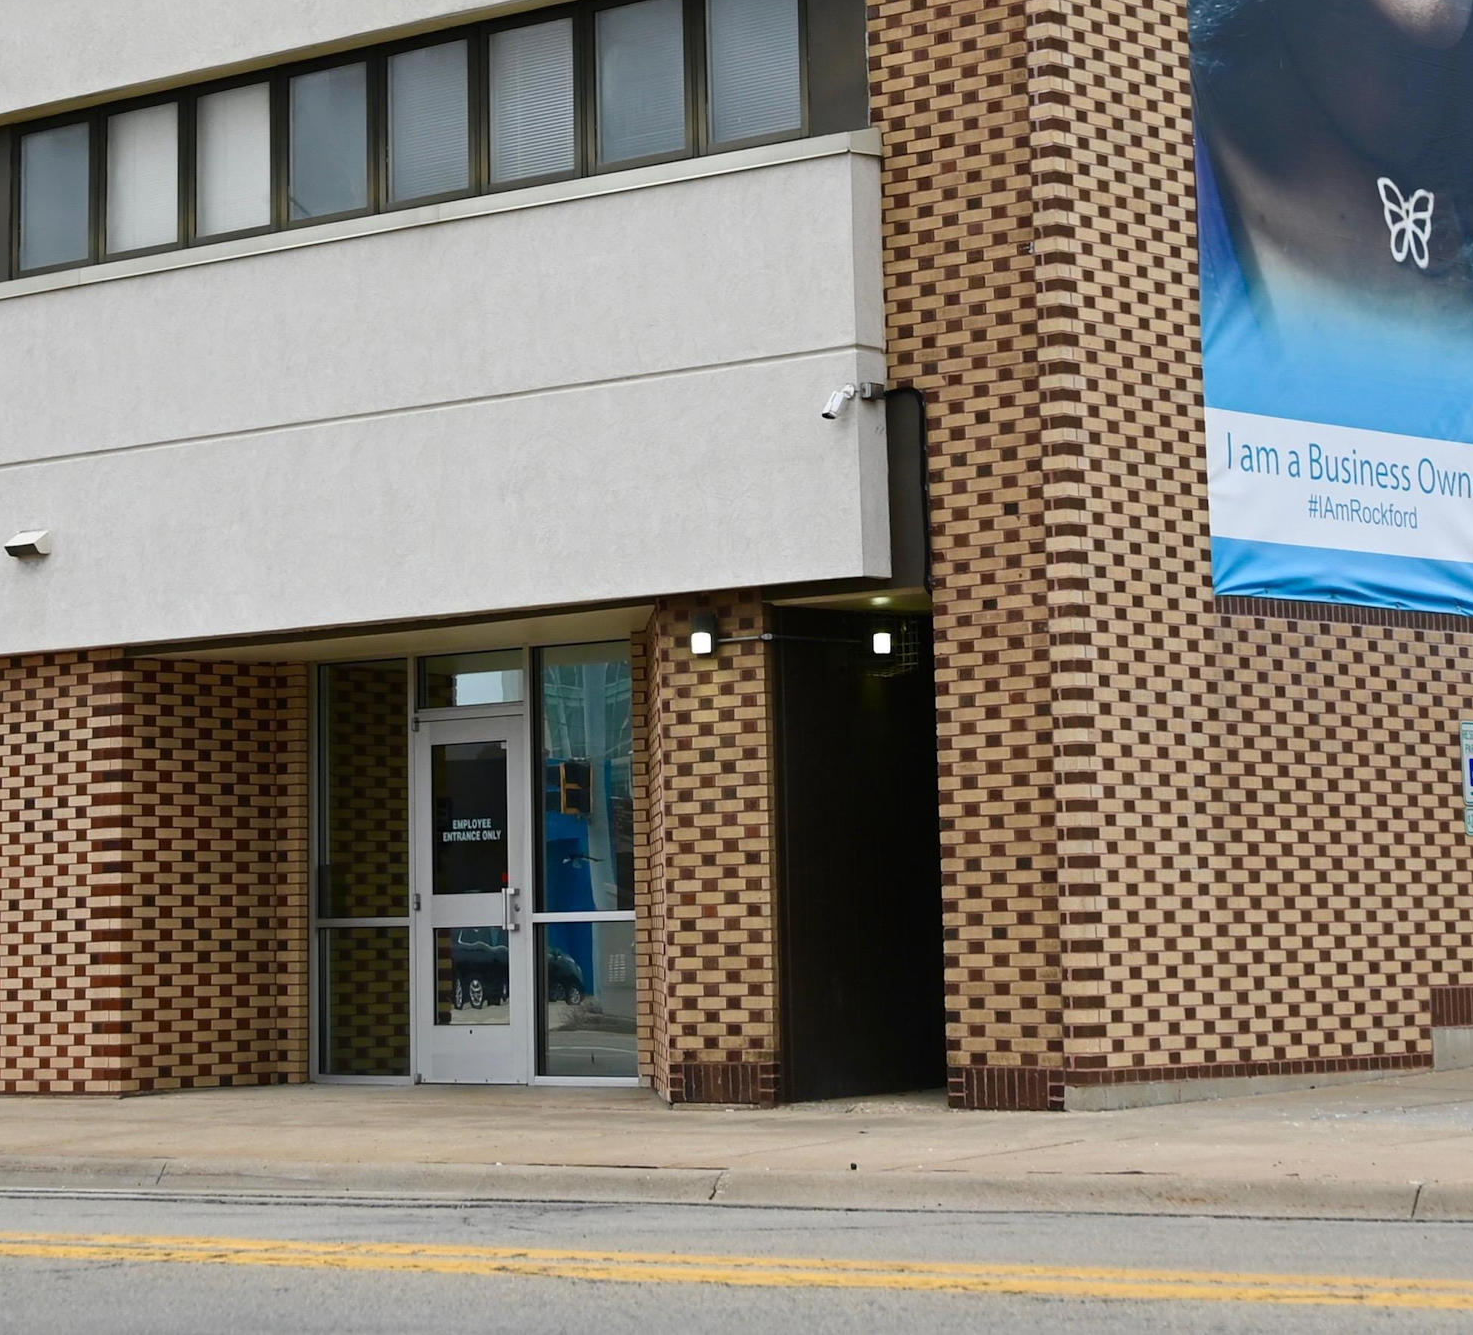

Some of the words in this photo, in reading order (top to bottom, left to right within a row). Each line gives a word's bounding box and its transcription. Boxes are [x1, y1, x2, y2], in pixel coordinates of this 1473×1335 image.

[1226, 432, 1232, 470] I
[1240, 443, 1280, 476] am
[1288, 449, 1301, 479] a
[1309, 443, 1411, 492] Business
[1308, 494, 1418, 529] #IAmRockford
[452, 818, 492, 830] EMPLOYEE
[443, 831, 481, 842] ENTRANCE
[482, 830, 502, 841] ONLY
